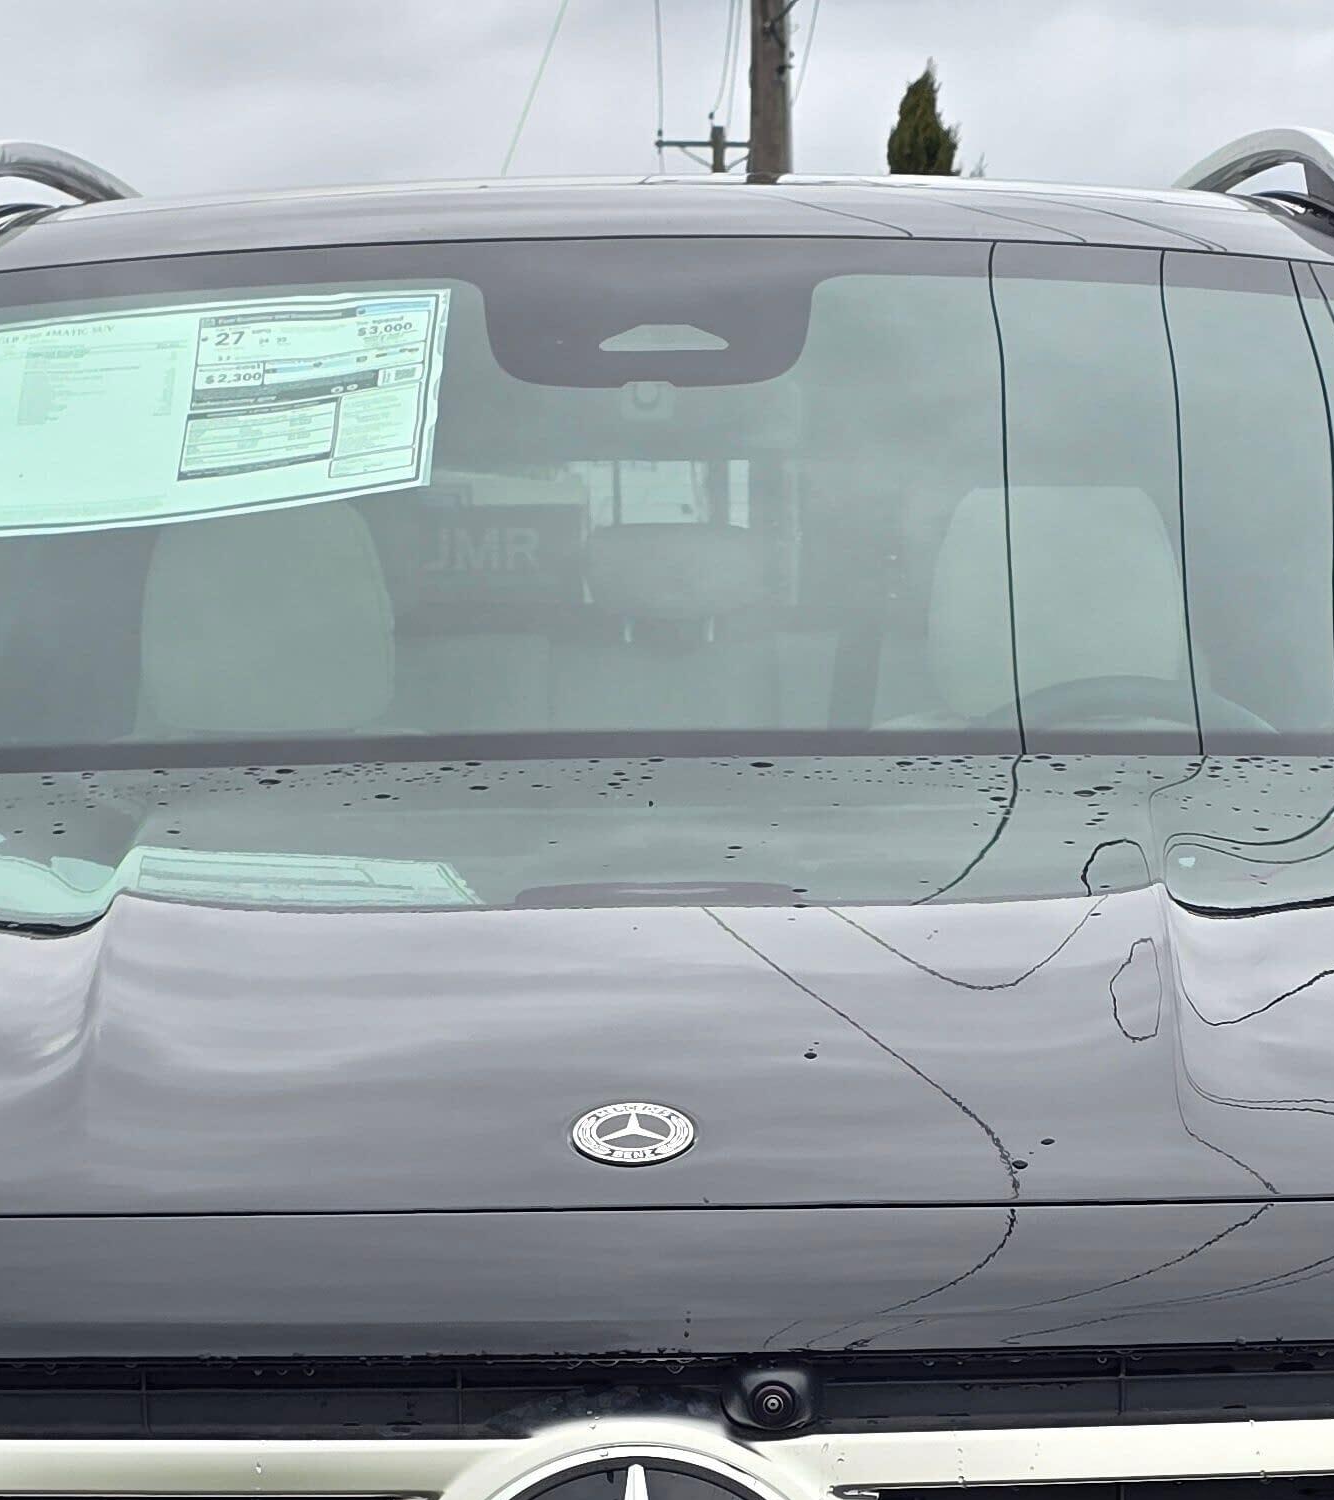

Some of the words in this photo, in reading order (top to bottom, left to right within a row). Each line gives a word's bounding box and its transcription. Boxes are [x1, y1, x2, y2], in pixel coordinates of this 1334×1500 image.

[356, 322, 413, 337] $3,000
[214, 330, 246, 346] 27
[205, 372, 262, 384] $2,300
